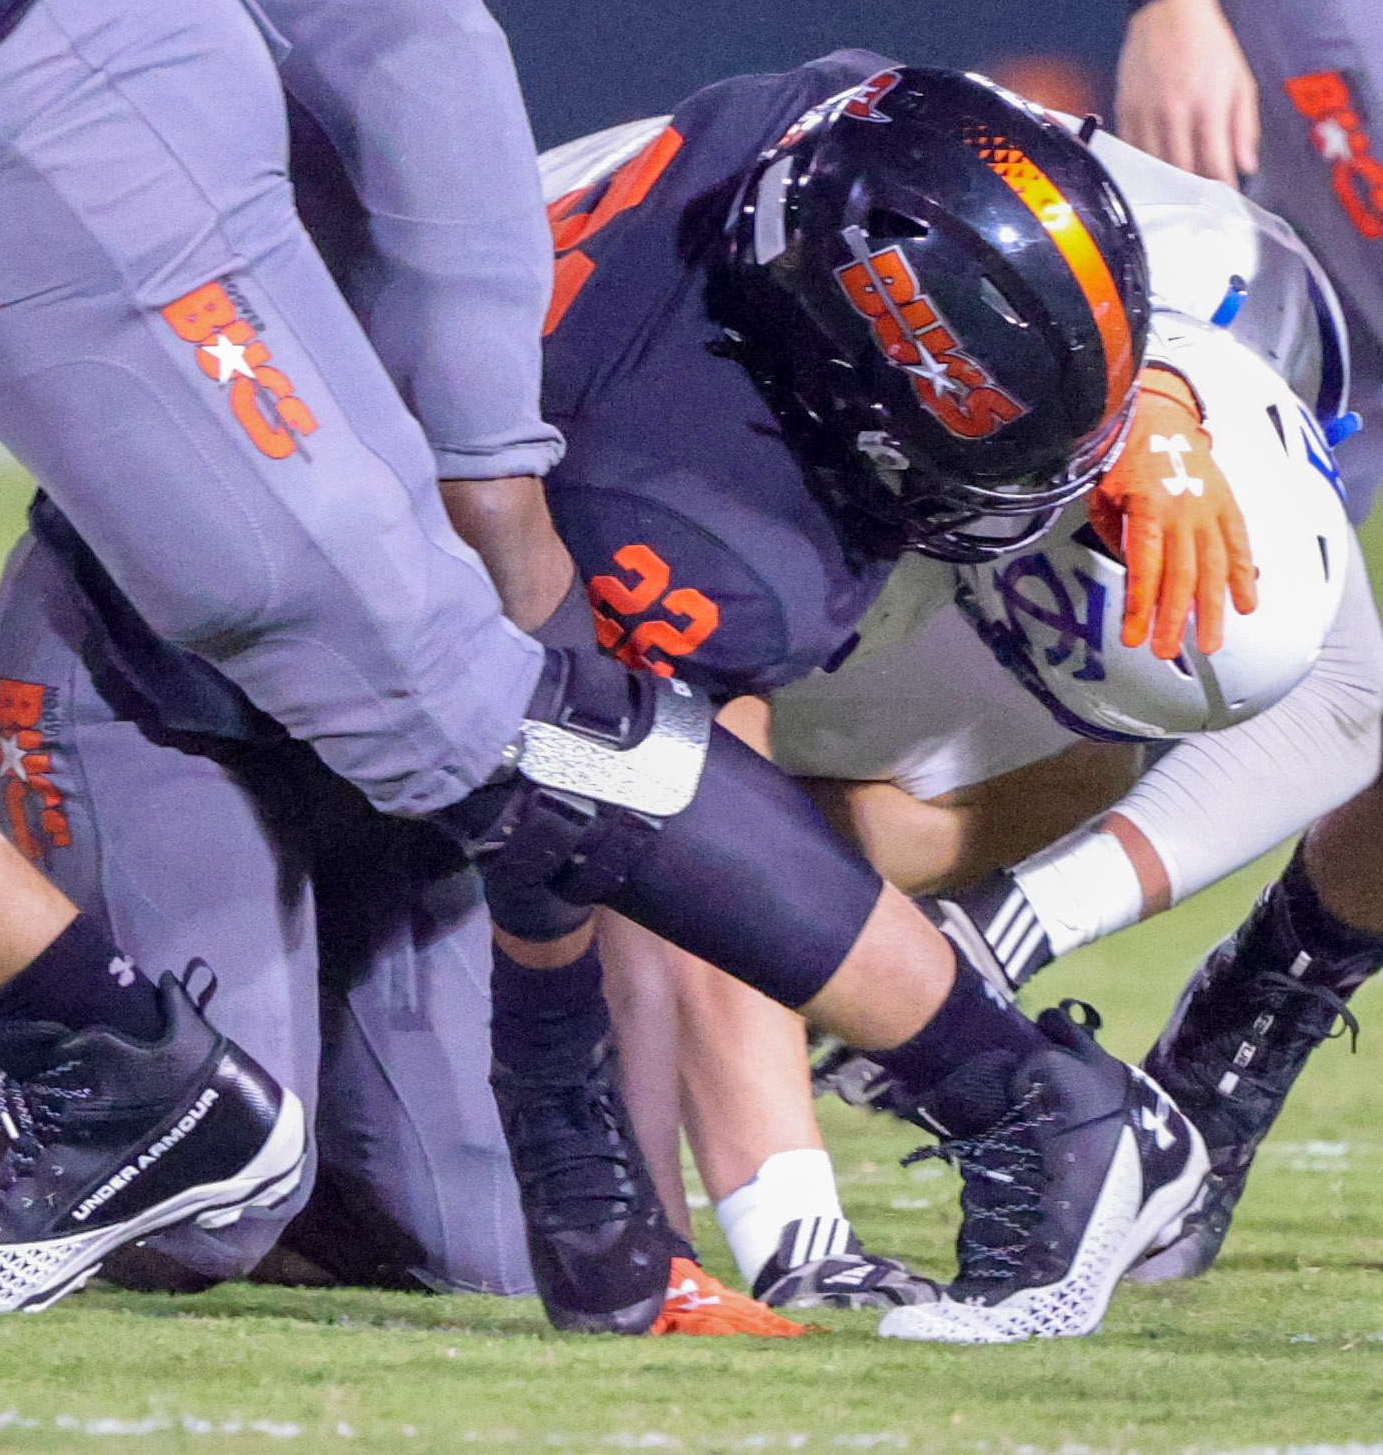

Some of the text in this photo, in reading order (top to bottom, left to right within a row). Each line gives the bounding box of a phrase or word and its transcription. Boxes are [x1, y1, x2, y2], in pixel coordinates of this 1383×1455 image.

[833, 245, 1028, 438] BUCS
[589, 544, 720, 678] 22
[71, 1088, 219, 1222] UNDER ARMOUR
